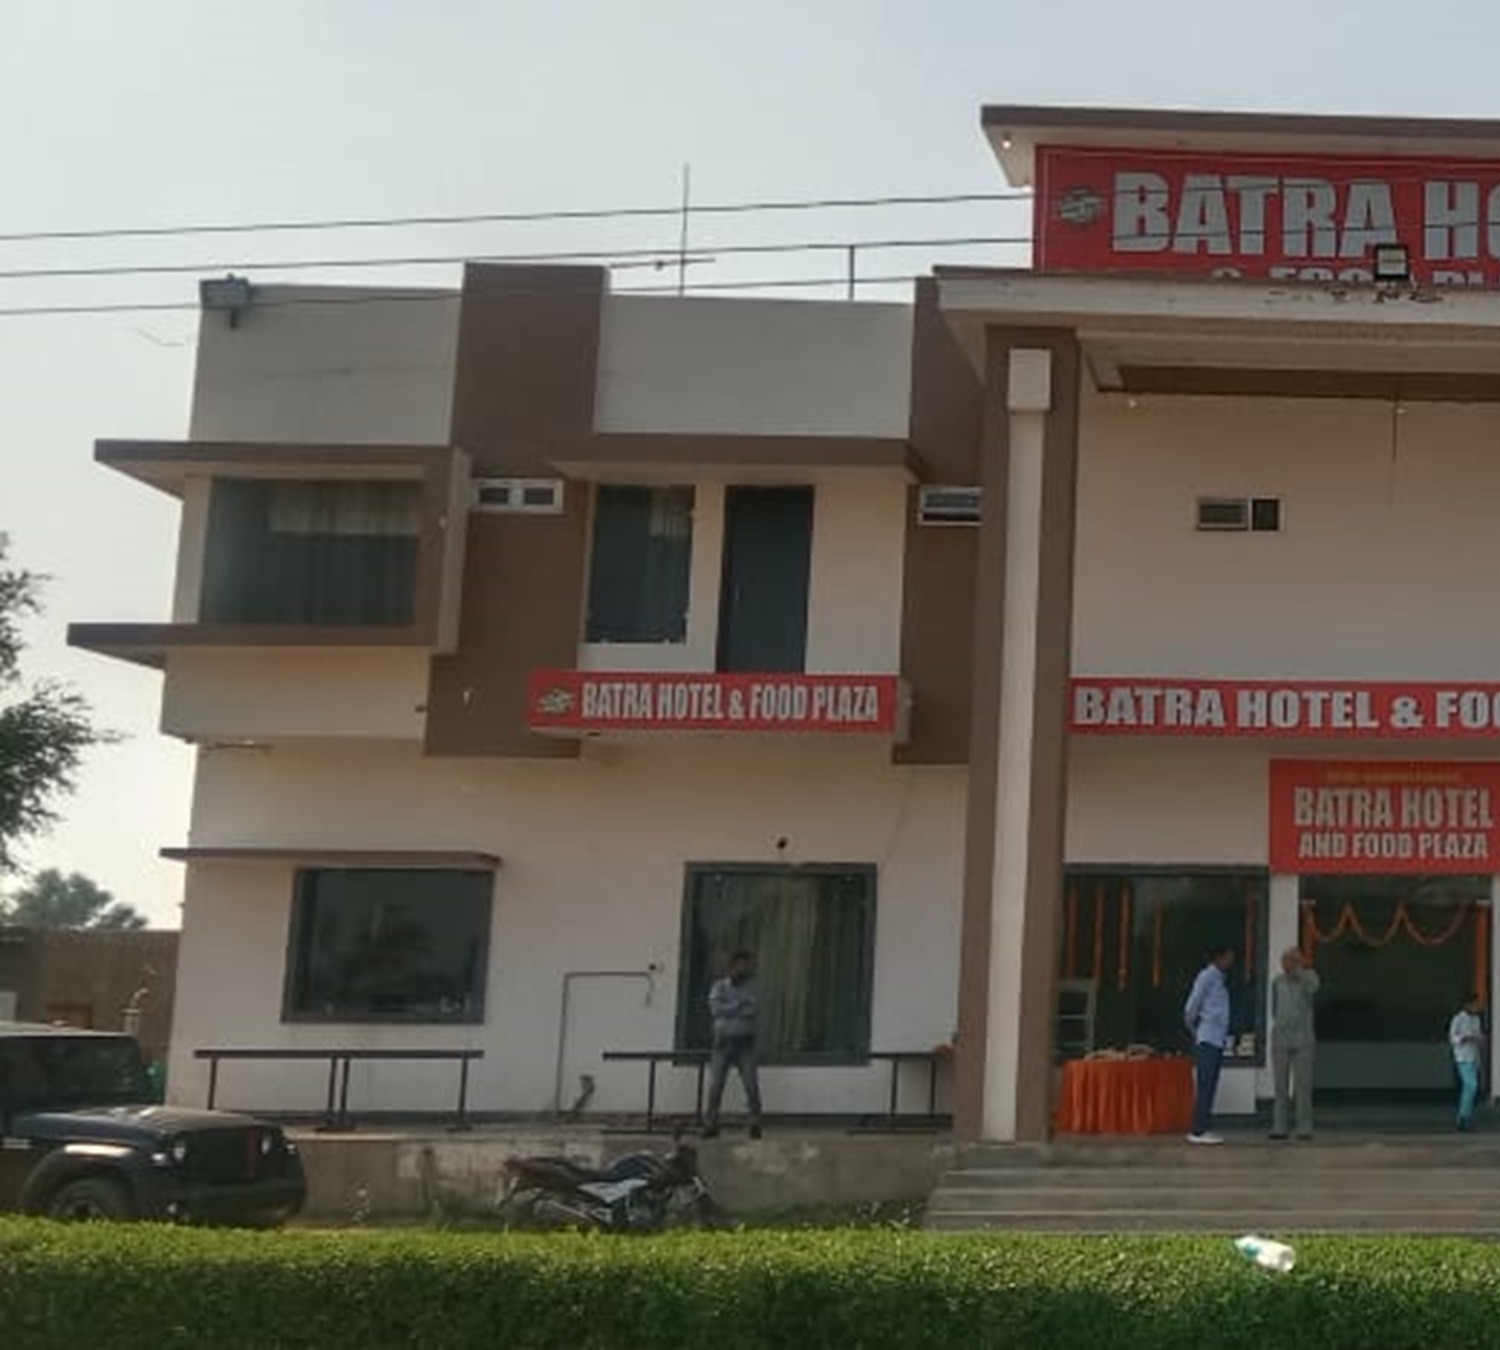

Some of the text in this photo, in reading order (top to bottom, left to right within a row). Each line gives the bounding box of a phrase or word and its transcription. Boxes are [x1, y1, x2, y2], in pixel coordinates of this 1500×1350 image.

[1113, 171, 1399, 258] BATRA
[583, 682, 877, 722] BATRA HOTEL & FOOD PLAZA
[1073, 686, 1224, 726] BATRA
[1238, 690, 1379, 728] HOTEL
[1390, 696, 1423, 728] &
[1294, 787, 1493, 829] BATRA HOTEL
[1299, 832, 1488, 860] AND FOOD PLAZA
